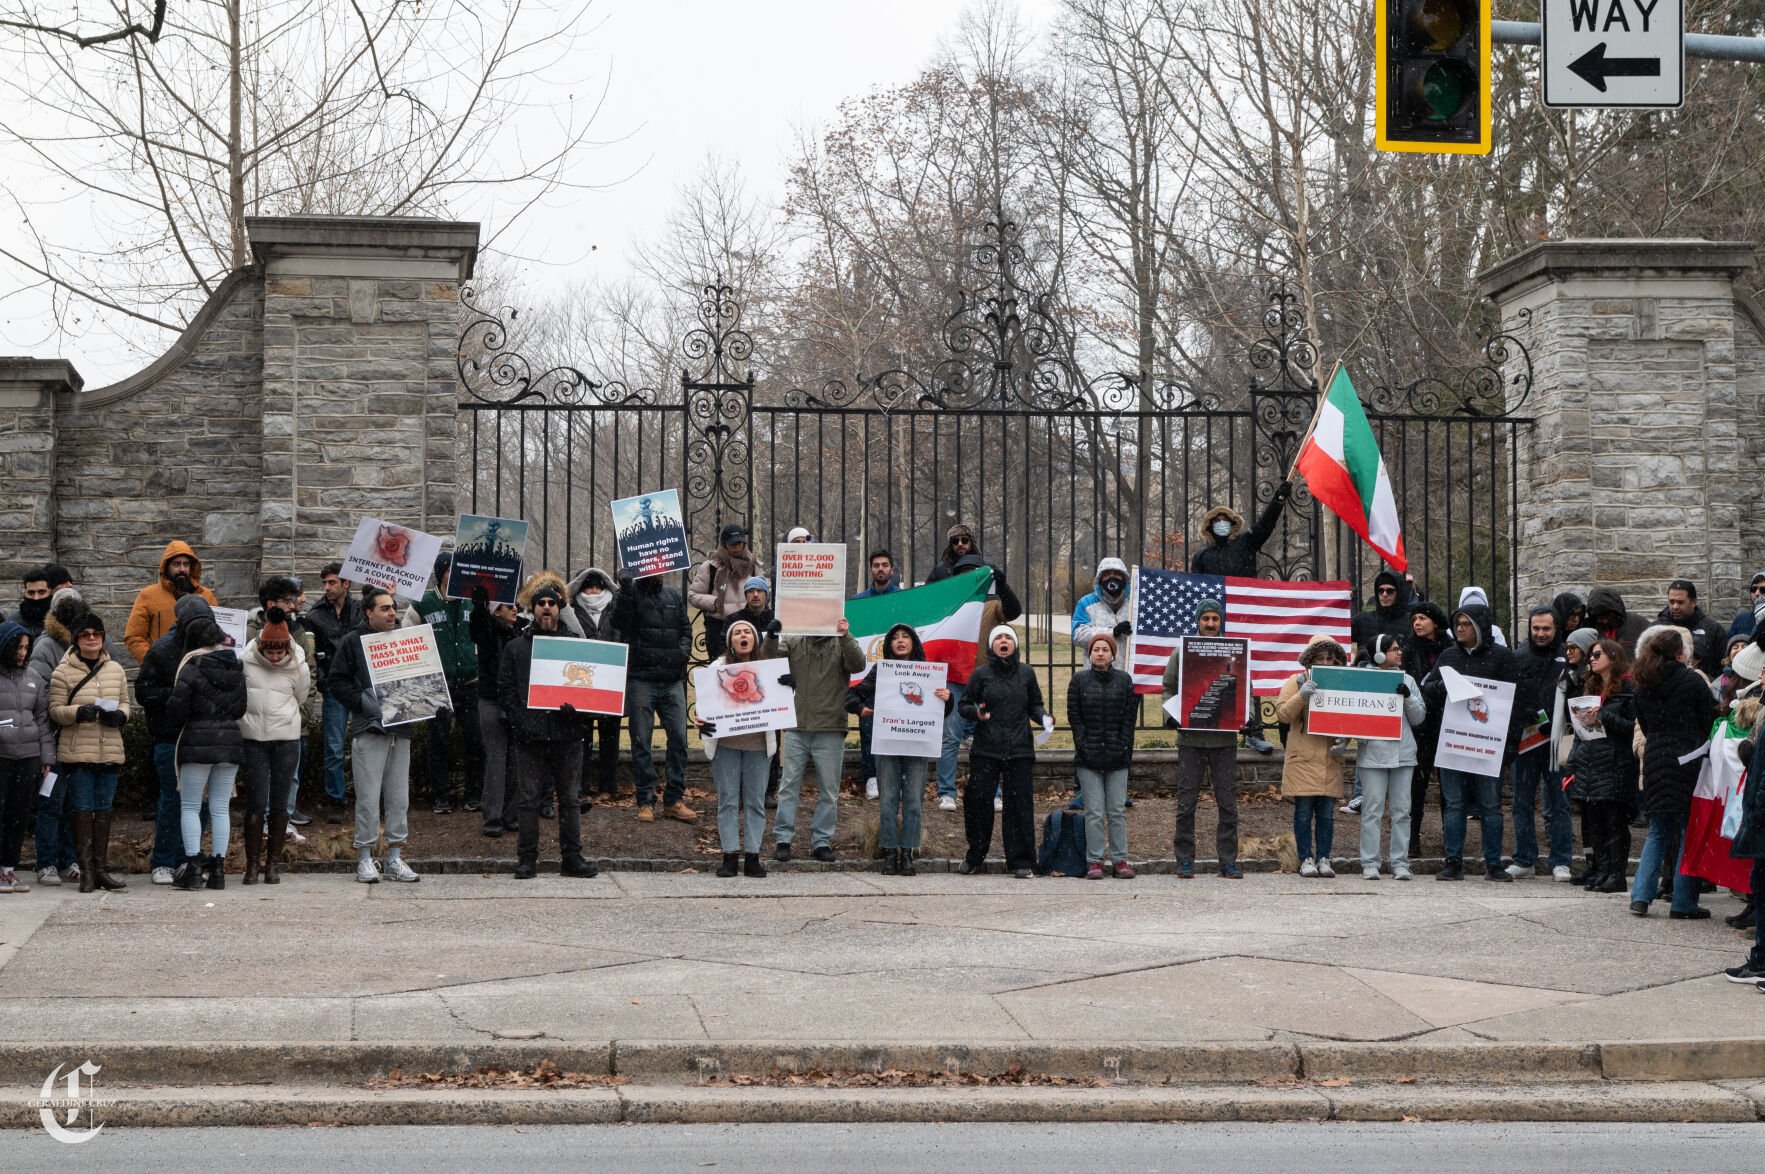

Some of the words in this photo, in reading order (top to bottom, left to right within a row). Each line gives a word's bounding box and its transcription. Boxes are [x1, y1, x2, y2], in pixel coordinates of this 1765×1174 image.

[1569, 0, 1659, 32] WAY
[627, 542, 654, 552] Human
[656, 537, 679, 548] rights
[628, 556, 660, 567] borders,
[662, 550, 683, 559] stand
[639, 549, 658, 557] have
[805, 554, 834, 562] 12,000
[349, 556, 385, 571] INTERNET
[386, 566, 425, 583] BLACKOUT
[638, 564, 656, 573] with
[658, 560, 675, 568] Iran
[781, 570, 824, 578] COUNTING
[371, 570, 396, 582] COVER
[397, 579, 413, 588] FOR
[368, 642, 388, 653] THIS
[389, 641, 398, 649] IS
[399, 636, 424, 646] WHAT
[370, 650, 395, 660] MASS
[396, 644, 429, 655] KILLING
[372, 658, 400, 669] LOOKS
[402, 653, 420, 663] LIKE
[1327, 696, 1355, 706] FREE
[1358, 698, 1384, 708] IRAN
[890, 726, 926, 734] Massacre
[907, 719, 935, 727] Largest
